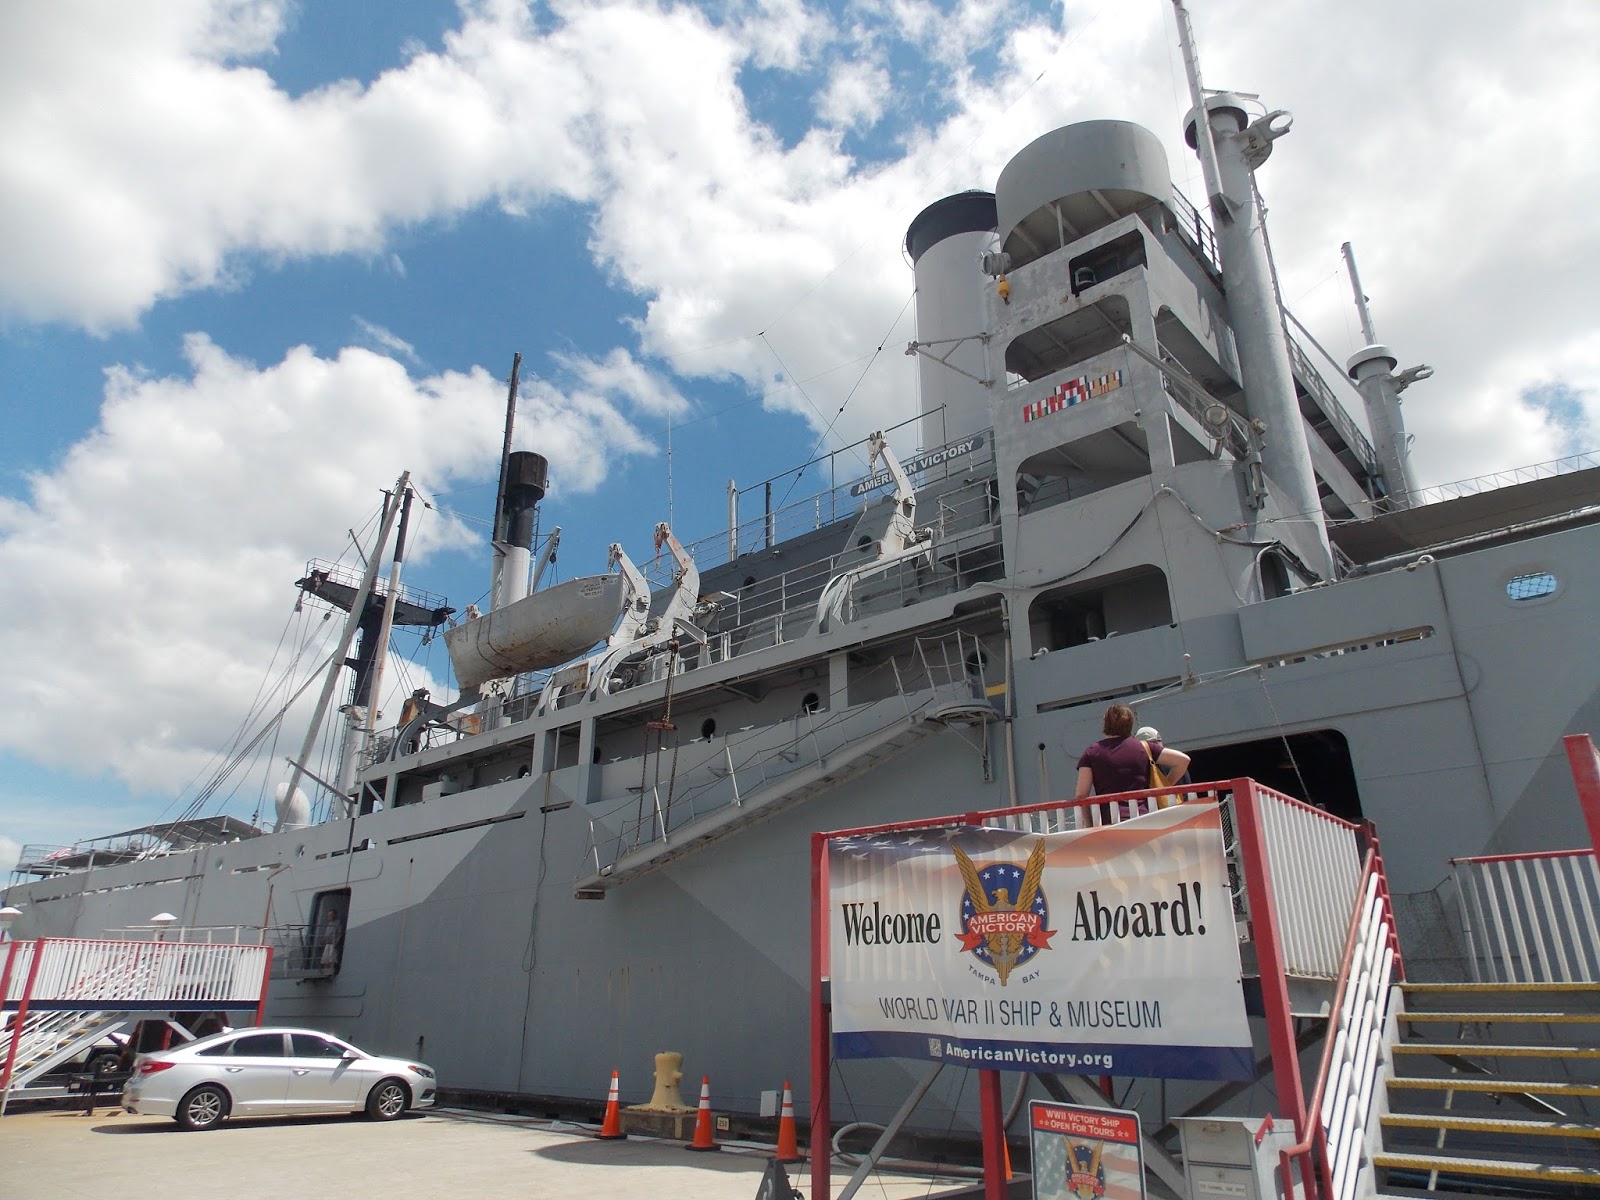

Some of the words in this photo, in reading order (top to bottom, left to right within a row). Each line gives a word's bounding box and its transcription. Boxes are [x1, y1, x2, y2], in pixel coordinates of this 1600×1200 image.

[857, 463, 917, 494] AMERIAN
[920, 440, 974, 468] VICTORY
[842, 901, 941, 946] Welcome
[1071, 881, 1206, 941] Aboard!
[970, 913, 1037, 926] AMERICAN
[972, 922, 1036, 934] VICTORY
[968, 964, 996, 985] TAMPA
[1021, 970, 1041, 984] BAY
[879, 997, 938, 1020] WORLD
[942, 997, 978, 1024] WAR
[984, 999, 995, 1025] II
[999, 1000, 1042, 1026] SHIP
[1049, 1001, 1062, 1028] &
[1067, 1000, 1162, 1028] MUSEUM
[946, 1042, 1113, 1069] AmericanVictory.org
[1046, 1109, 1066, 1120] WWII
[1068, 1112, 1100, 1125] VICTORY
[1101, 1117, 1120, 1128] SHIP
[1050, 1119, 1070, 1131] OPEN
[1072, 1122, 1087, 1133] FOR
[1088, 1125, 1115, 1137] TOURS
